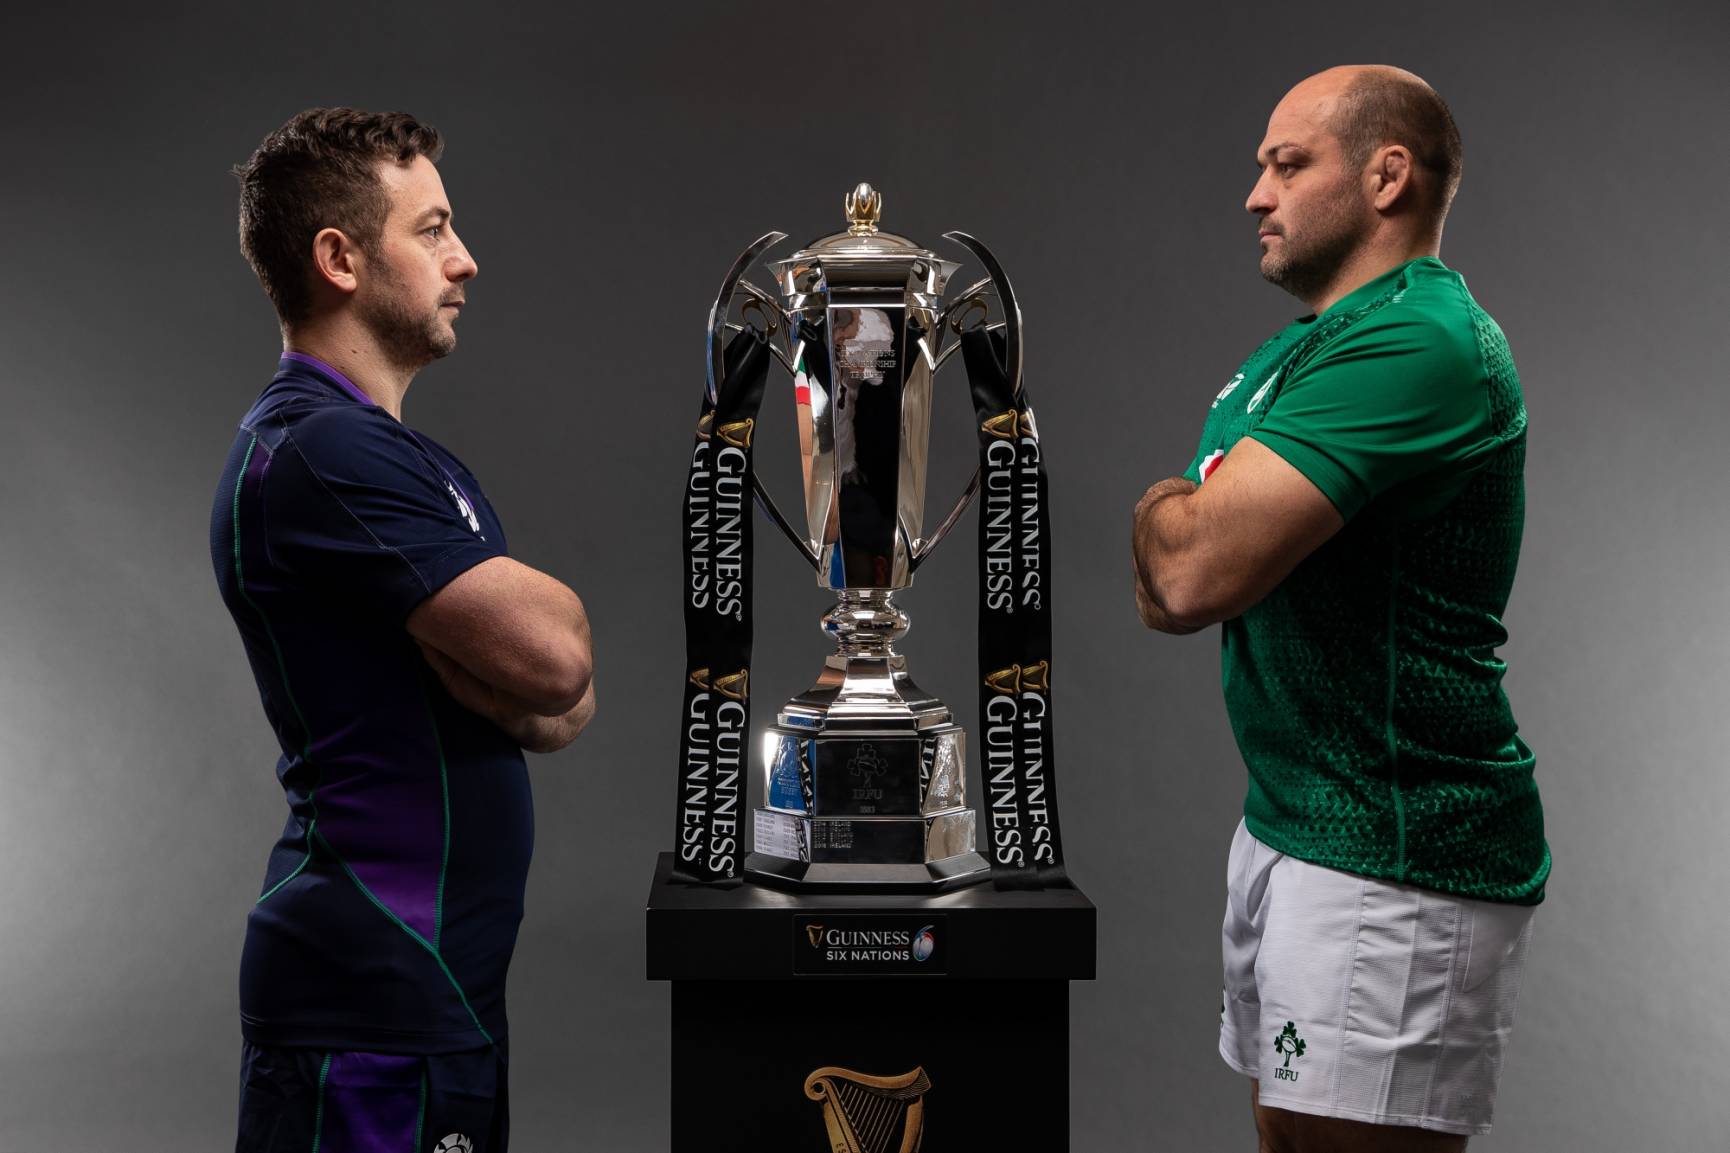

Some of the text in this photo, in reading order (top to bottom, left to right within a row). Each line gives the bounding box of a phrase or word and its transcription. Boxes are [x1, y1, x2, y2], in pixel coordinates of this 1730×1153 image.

[716, 447, 747, 615] GUINNESS
[986, 439, 1016, 609] GUINNESS
[709, 701, 746, 872] GUINNESS
[987, 695, 1024, 864] GUINNESS
[826, 929, 910, 945] GUINNESS
[826, 950, 910, 961] SIX NATIONS
[1274, 1067, 1299, 1082] IRFU
